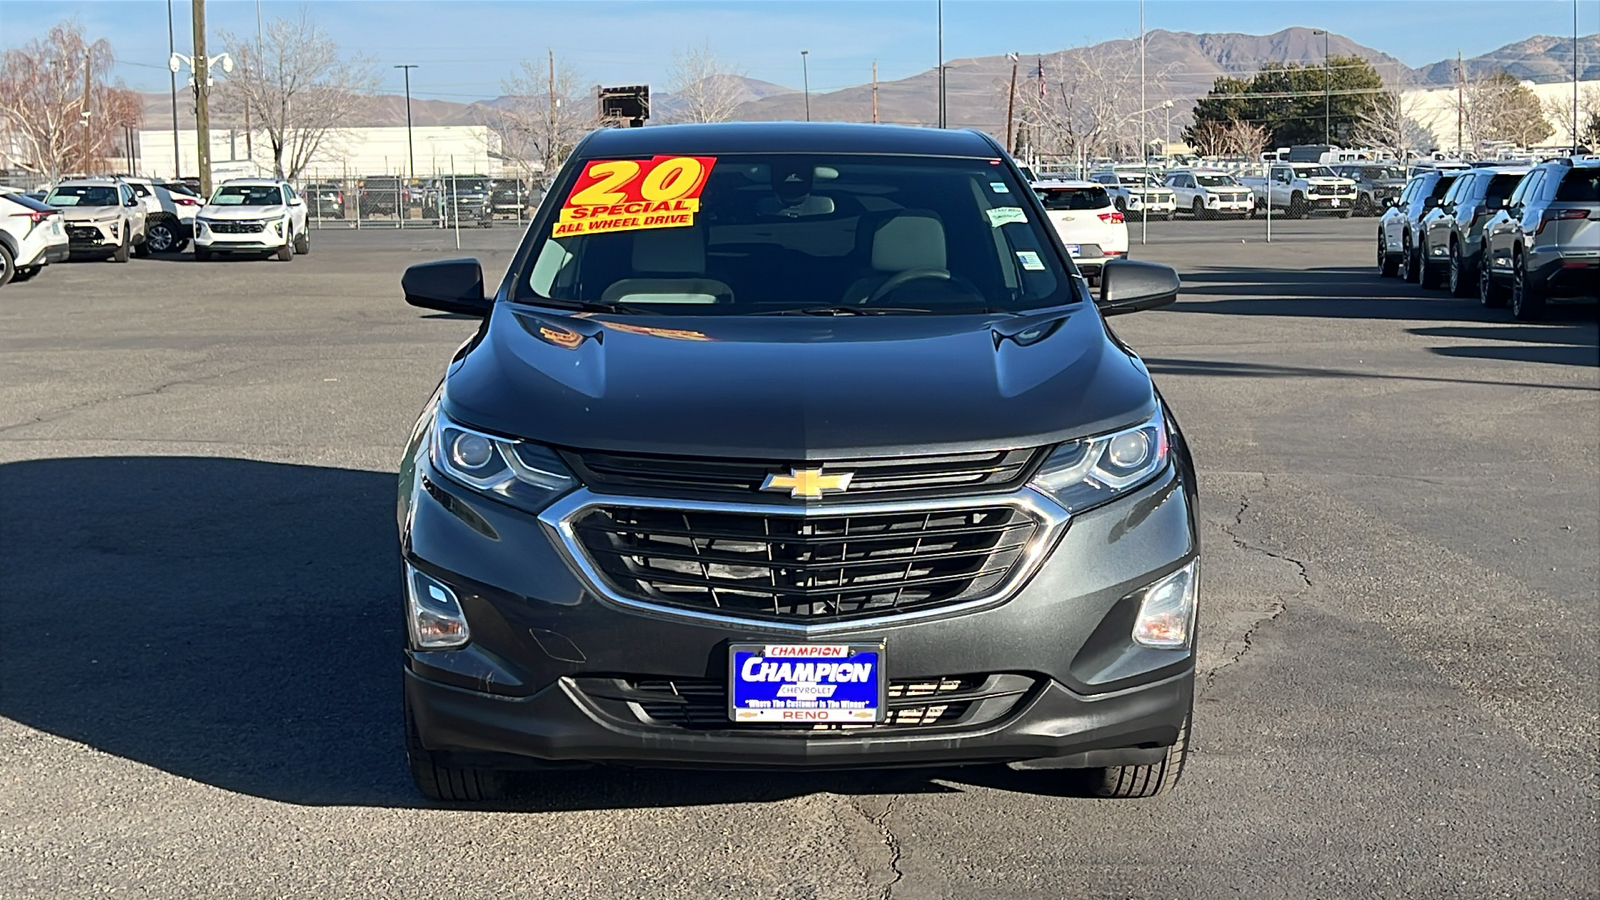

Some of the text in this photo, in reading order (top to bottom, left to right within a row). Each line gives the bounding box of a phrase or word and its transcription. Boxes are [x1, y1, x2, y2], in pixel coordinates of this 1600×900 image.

[570, 157, 705, 206] 20
[571, 201, 691, 219] SPECIAL
[555, 214, 690, 235] ALL WHEEL DRIVE
[771, 646, 842, 656] CHAMPION
[741, 657, 872, 683] CHAMPION
[772, 699, 785, 708] The
[786, 699, 818, 708] Customer
[827, 699, 840, 708] The
[783, 711, 829, 720] RENO
